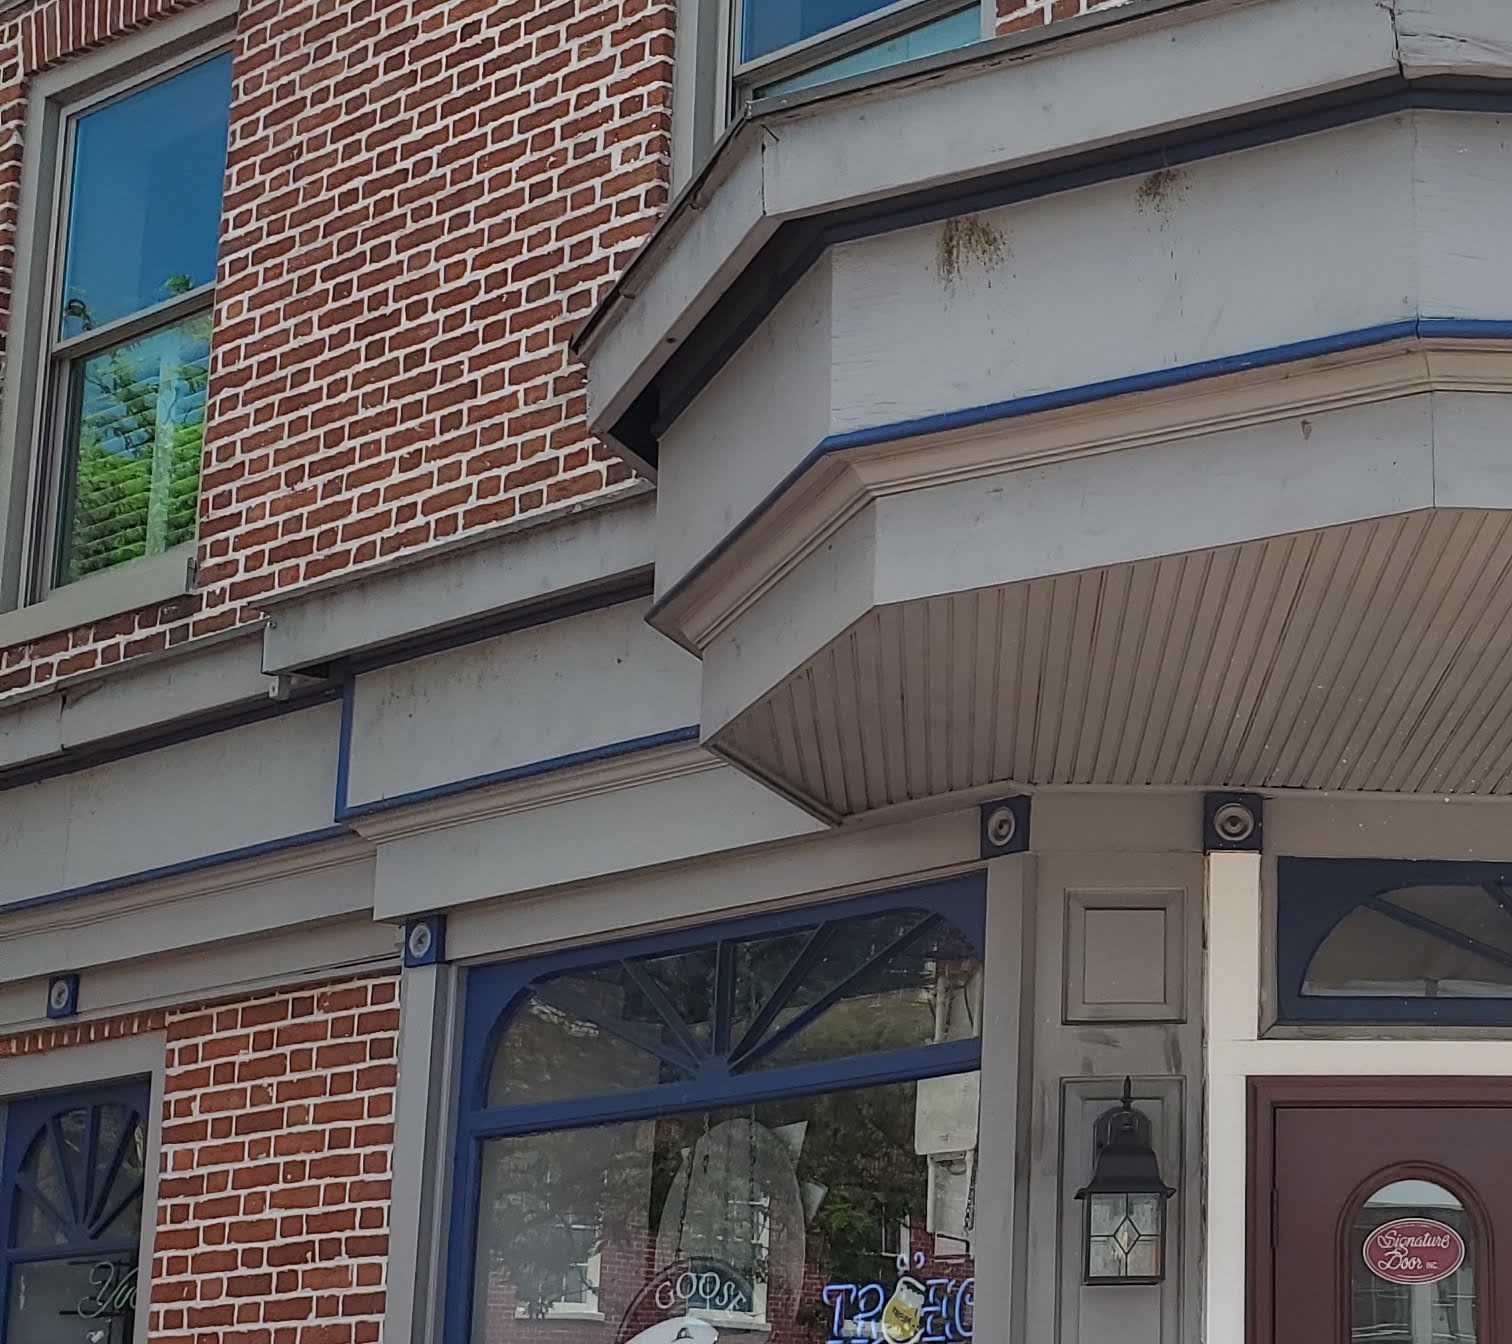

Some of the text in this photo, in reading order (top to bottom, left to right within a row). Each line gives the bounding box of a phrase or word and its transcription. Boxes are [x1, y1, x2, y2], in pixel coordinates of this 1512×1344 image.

[1377, 1230, 1450, 1257] Signature
[1378, 1250, 1423, 1270] Door
[655, 1272, 747, 1318] GOOSE
